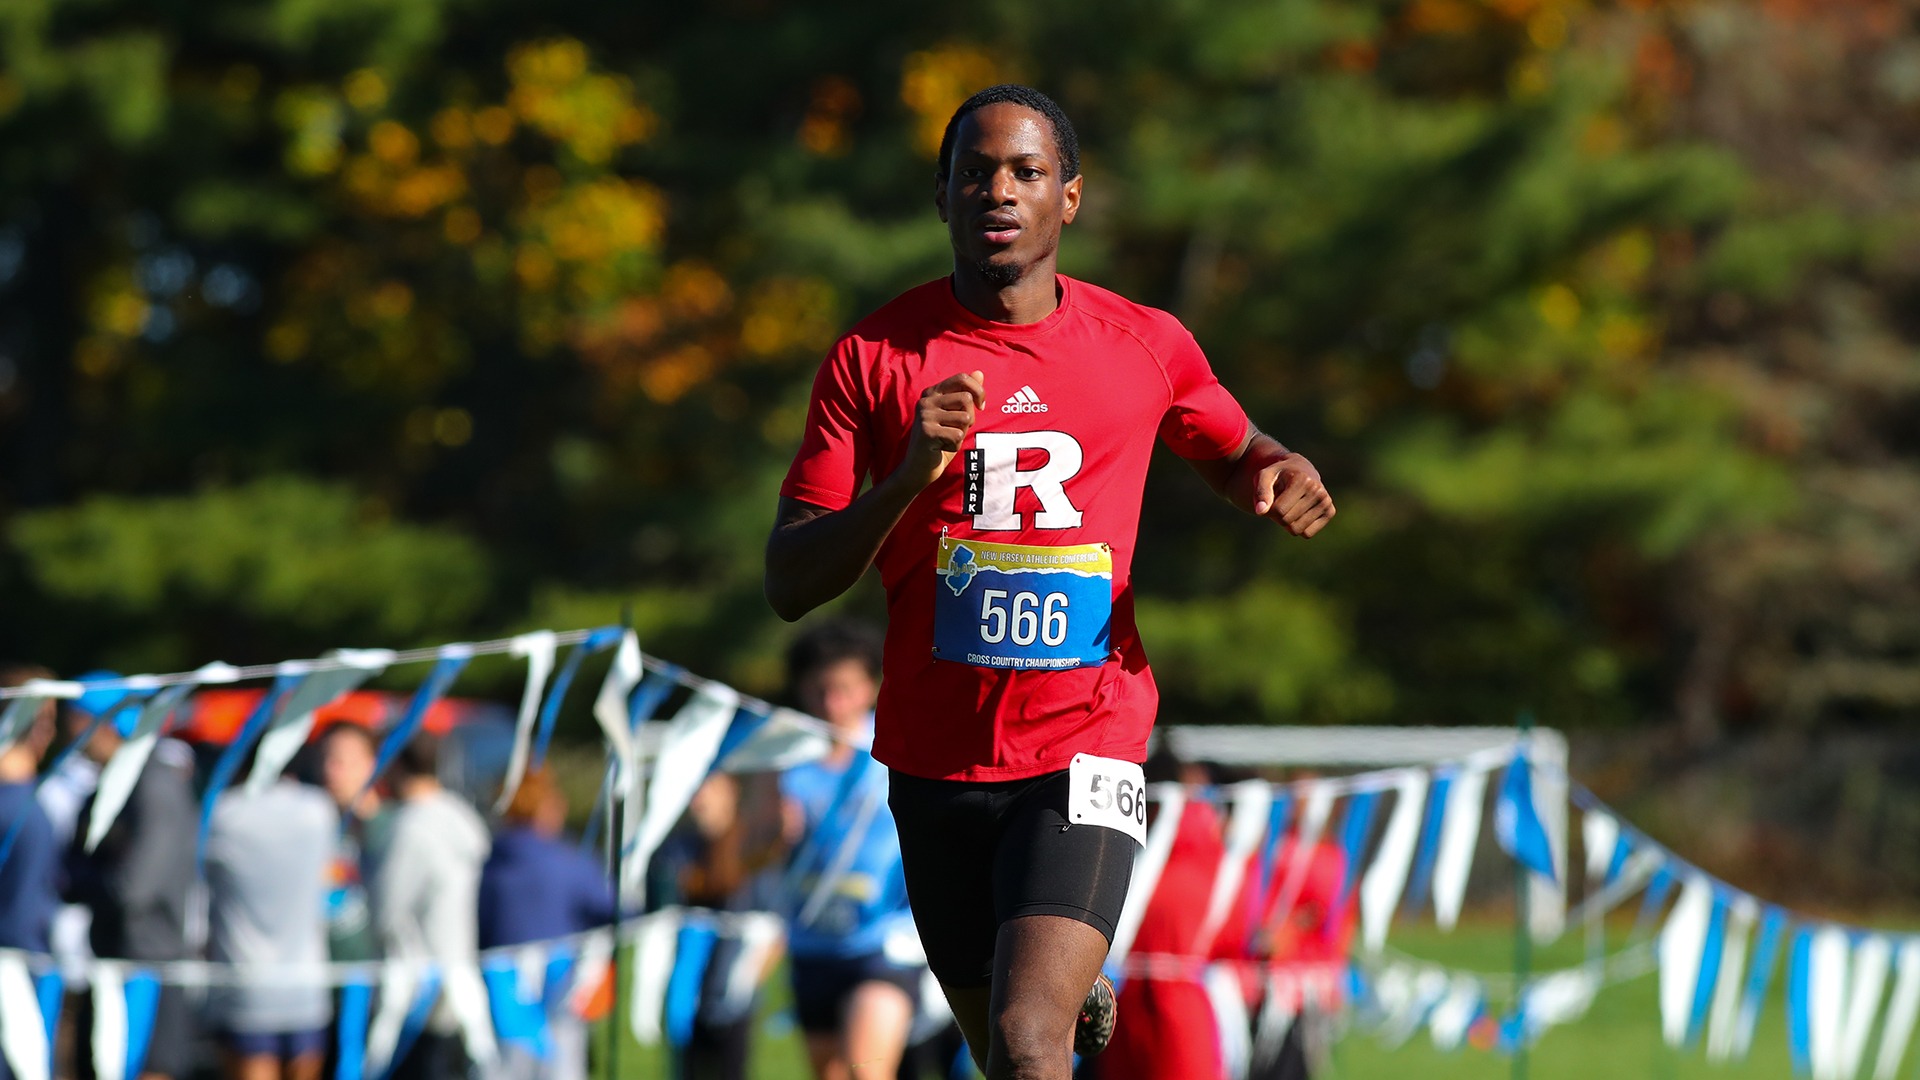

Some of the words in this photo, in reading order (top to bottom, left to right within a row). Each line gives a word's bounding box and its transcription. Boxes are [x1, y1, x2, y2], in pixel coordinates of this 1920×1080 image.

[1001, 402, 1048, 414] adidas
[968, 451, 979, 513] NEWARK
[972, 430, 1084, 532] R
[981, 551, 997, 561] NEW
[999, 552, 1024, 563] JERSEY
[1026, 554, 1059, 564] ATHLETIC
[1060, 552, 1098, 564] CONFERENCE
[980, 589, 1069, 647] 566
[967, 653, 990, 665] CROSS
[991, 656, 1025, 667] COUNTRY
[1025, 657, 1081, 668] CHAMPIONSHIPS
[1090, 774, 1145, 826] 566
